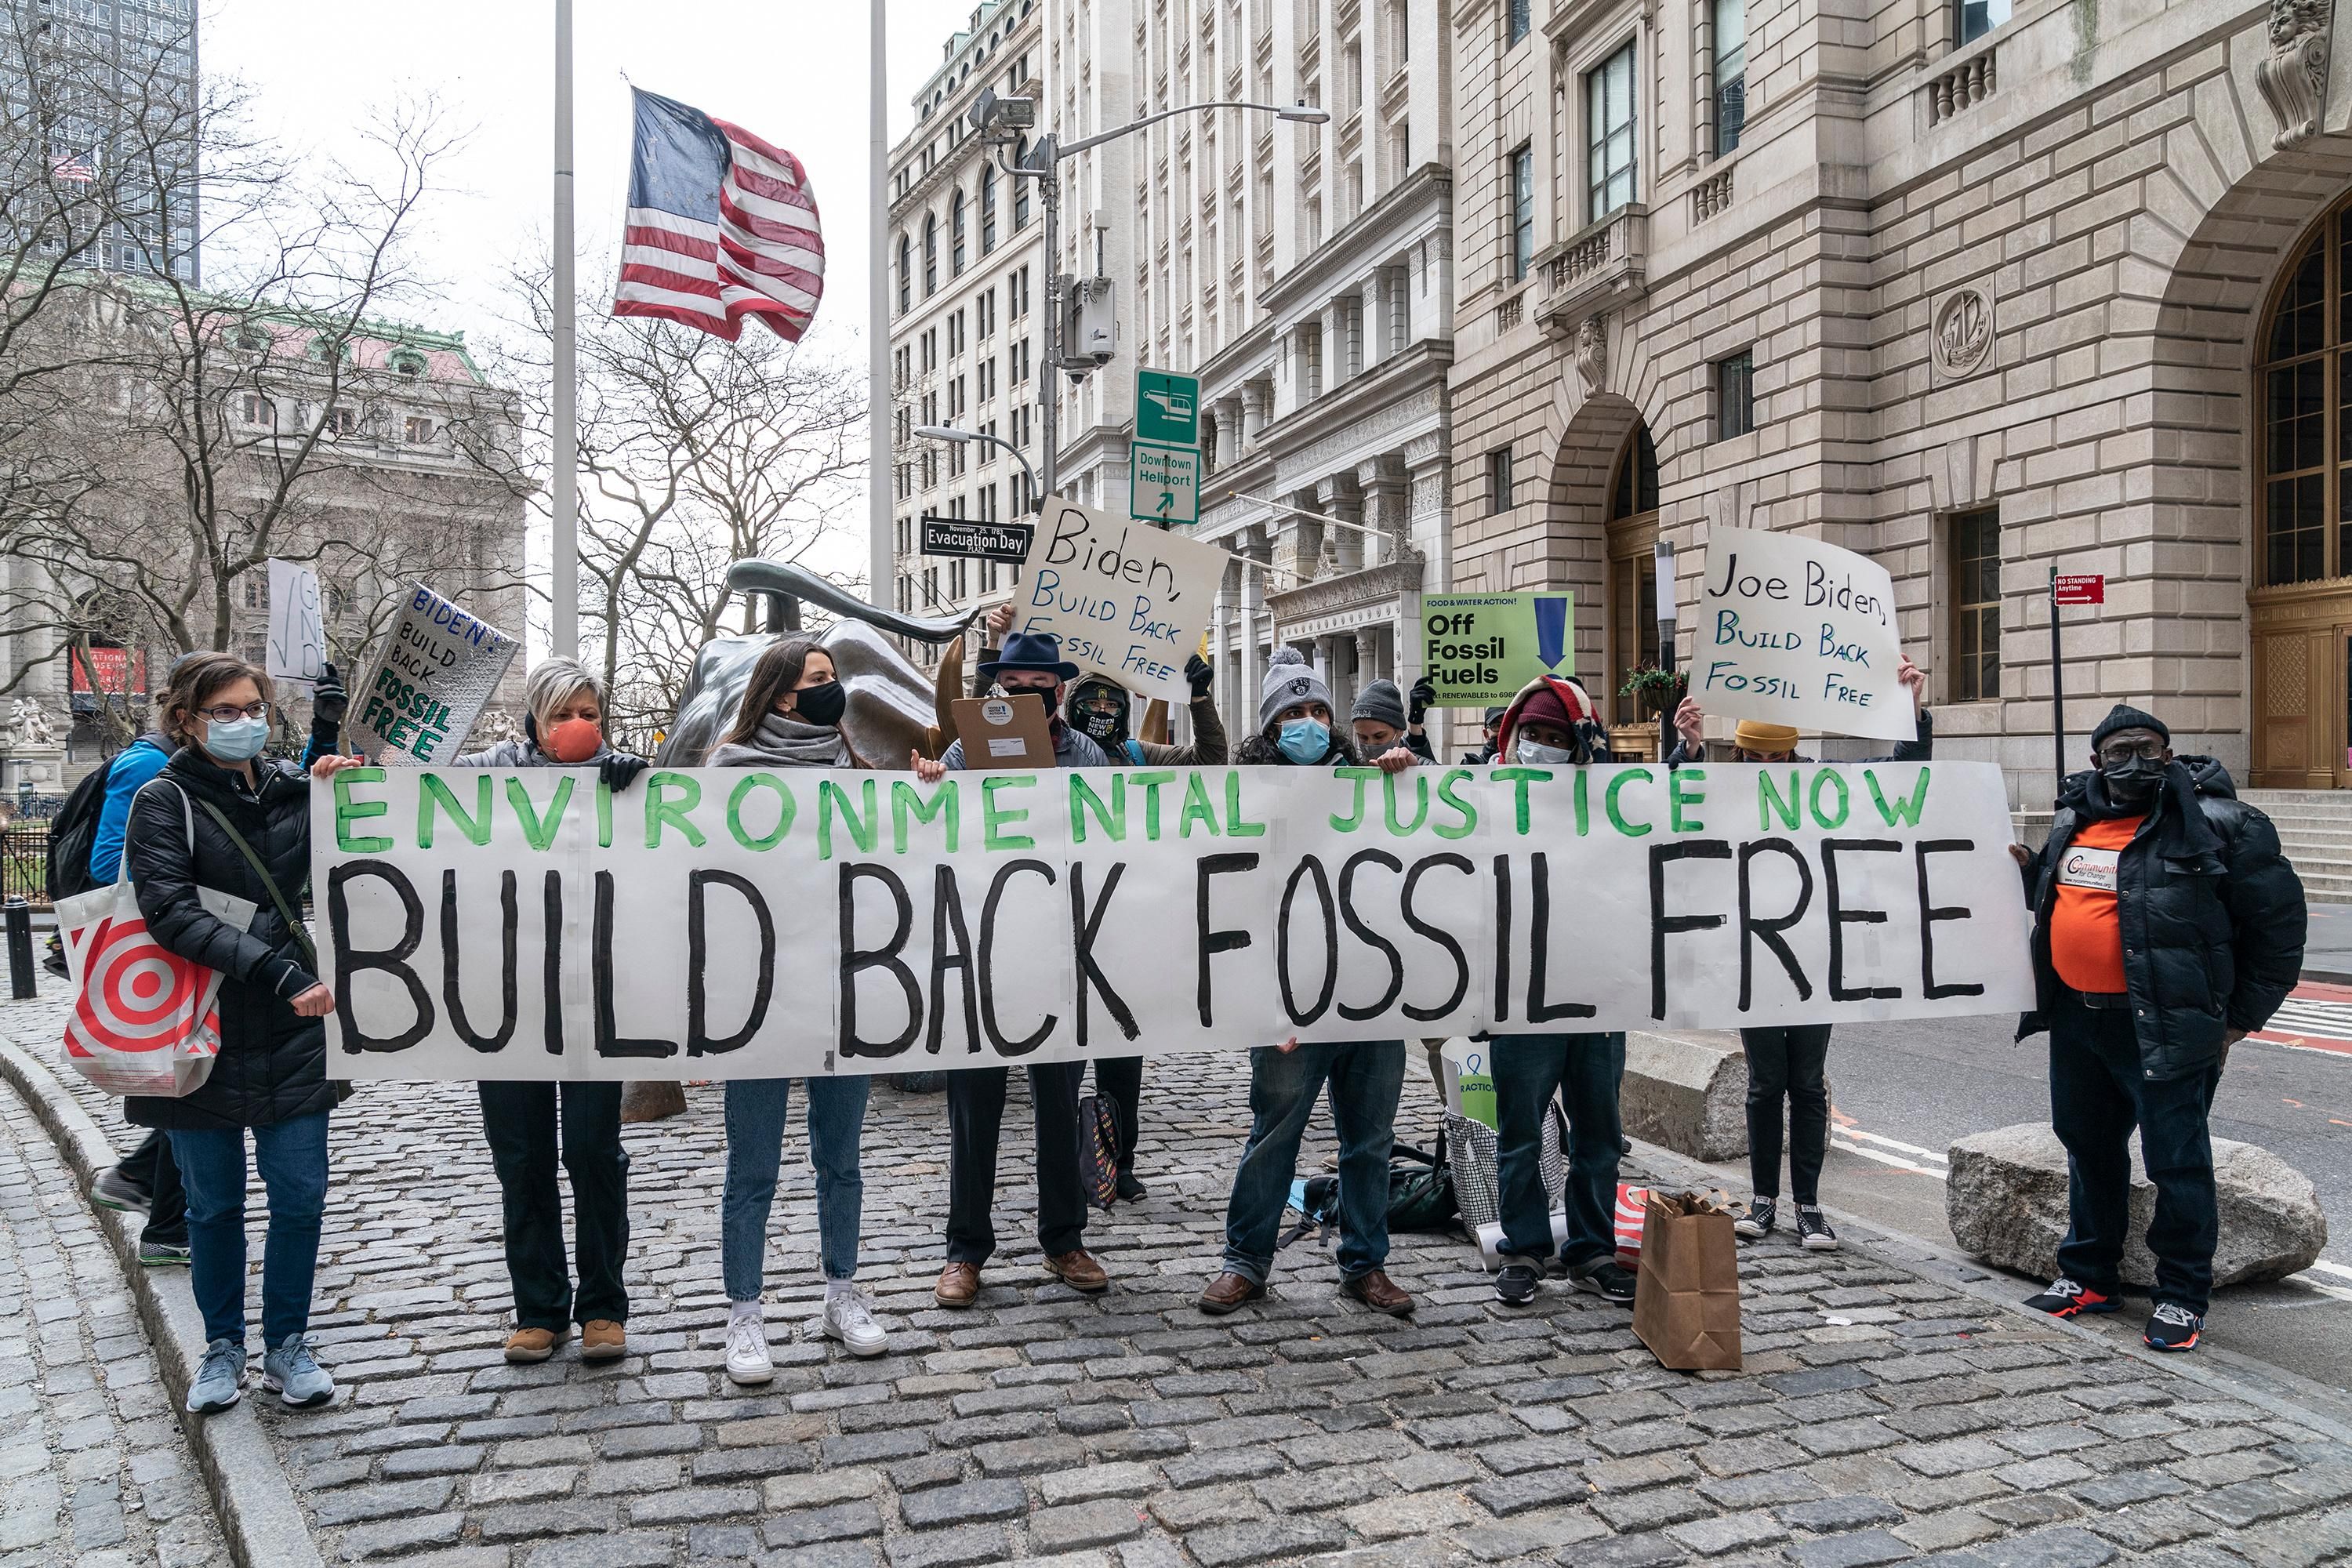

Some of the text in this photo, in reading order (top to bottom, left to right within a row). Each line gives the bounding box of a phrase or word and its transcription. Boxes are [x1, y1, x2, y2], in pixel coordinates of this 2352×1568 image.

[1140, 452, 1192, 470] Downtown
[1140, 470, 1191, 487] Heliport
[928, 528, 1023, 554] Evacuation Day
[949, 524, 975, 533] November
[1046, 508, 1181, 602] Biden,
[1708, 553, 1886, 626] Joe Biden,
[1032, 569, 1181, 644] BUILD BACK
[1427, 613, 1474, 636] Off
[1715, 609, 1870, 669] BUILD BACK
[399, 621, 456, 667] BUILD
[1428, 636, 1504, 660] Fossil
[391, 644, 436, 686] BACK
[1121, 644, 1176, 681] FREE
[1428, 662, 1499, 685] Fuels
[1288, 677, 1309, 688] NETS
[1706, 661, 1873, 707] FOSSIL FREE
[375, 667, 451, 734] FOSSIL
[361, 696, 443, 764] FREE
[1087, 728, 1106, 736] DEAL
[1088, 721, 1106, 730] NEW
[1090, 716, 1115, 724] GREEN
[334, 767, 1929, 861] ENVIRONMENTAL JUSTICE NOW
[2087, 872, 2106, 880] Change
[328, 837, 1984, 1058] BUILD BACK FOSSIL FREE
